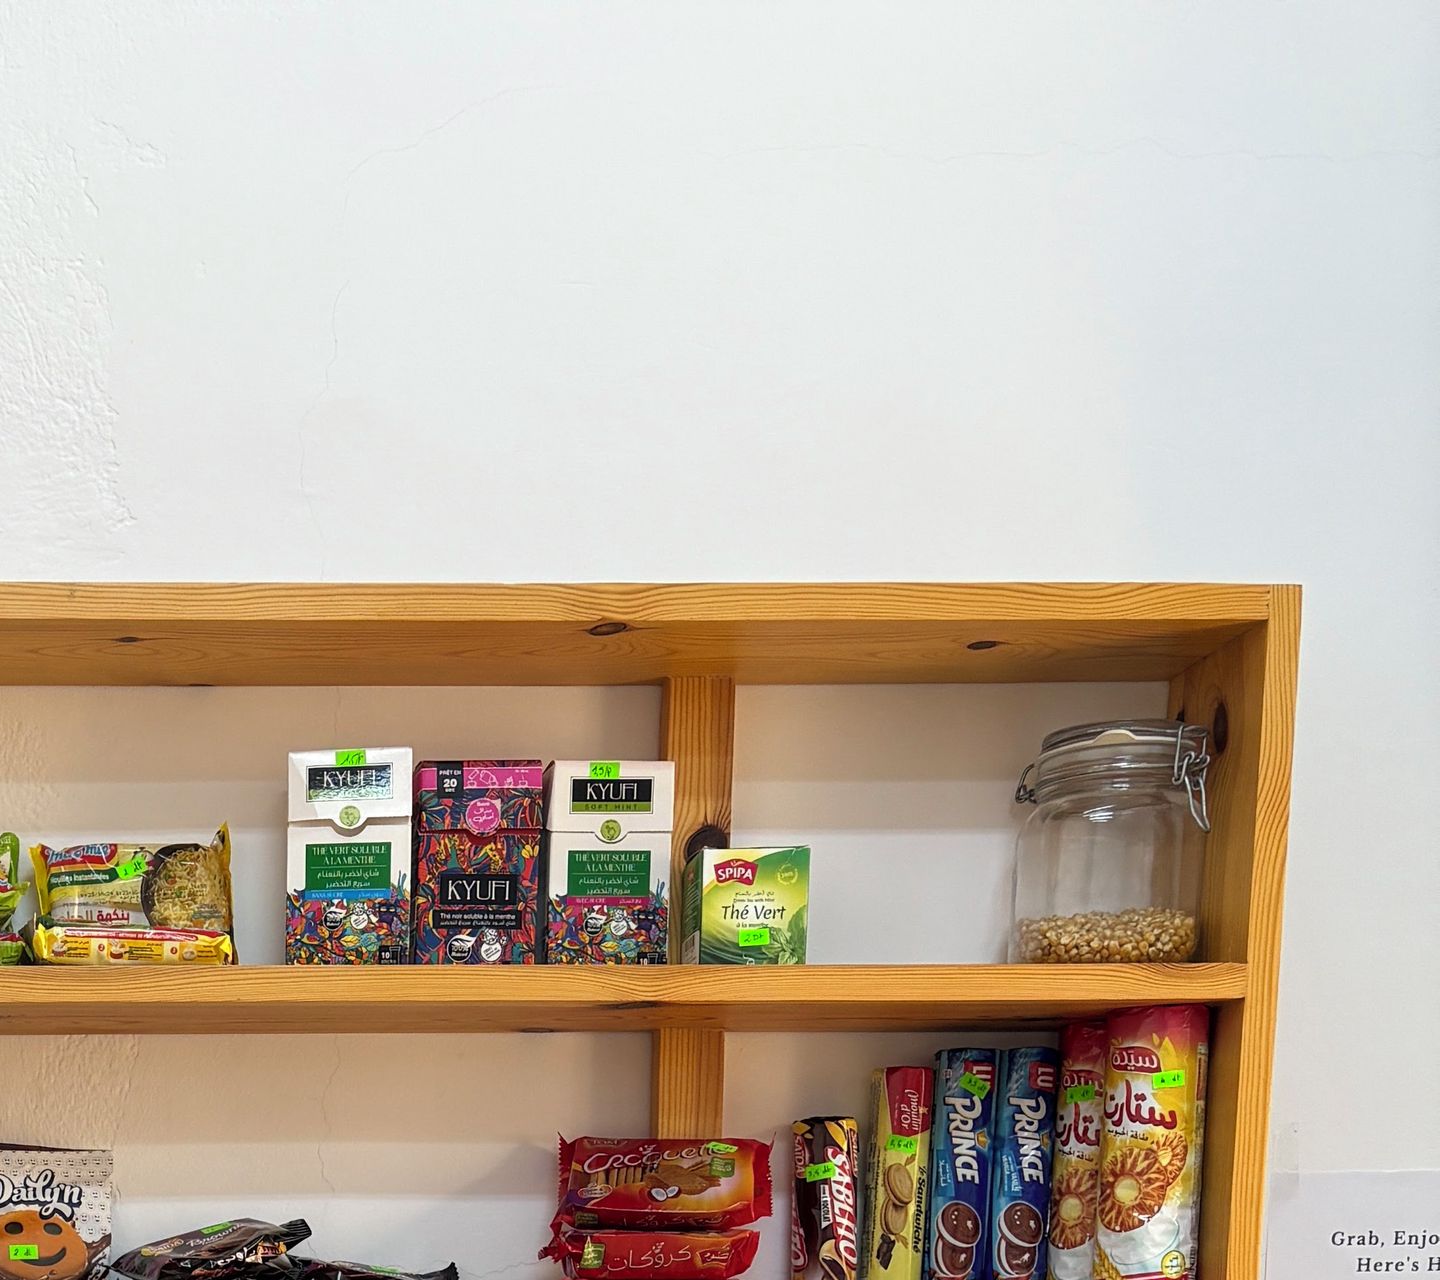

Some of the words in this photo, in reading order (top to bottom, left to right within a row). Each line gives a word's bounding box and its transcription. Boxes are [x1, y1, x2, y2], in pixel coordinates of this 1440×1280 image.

[443, 778, 457, 788] 20
[586, 783, 637, 800] KYUFI
[718, 867, 752, 880] SPIPA
[448, 880, 510, 900] KYUFI
[722, 904, 749, 920] Thé
[754, 905, 786, 920] Vert
[1038, 1067, 1054, 1088] LU
[945, 1096, 983, 1185] PRINCE
[1009, 1096, 1047, 1185] PRINCE
[1331, 1231, 1385, 1247] Grab,
[1356, 1256, 1419, 1272] Here's
